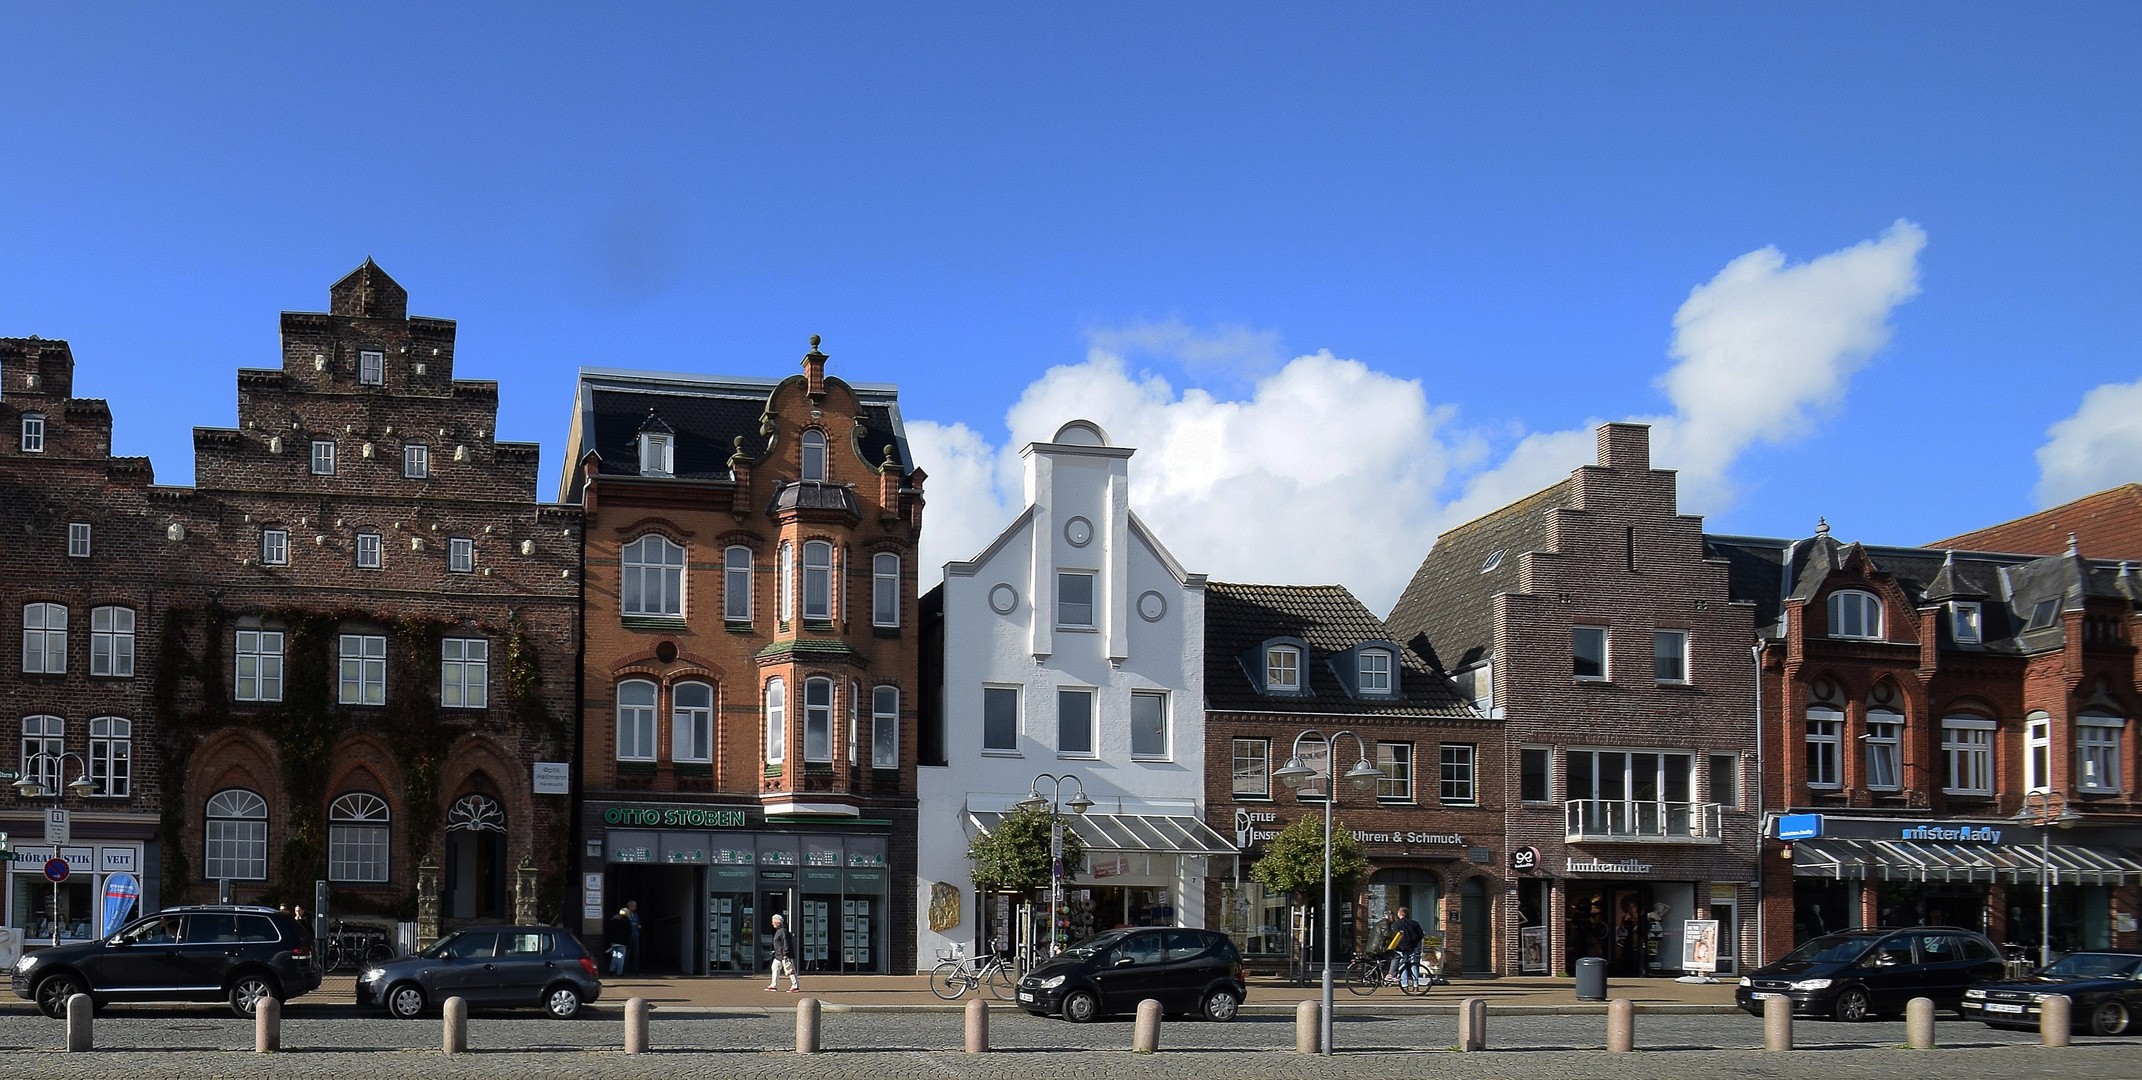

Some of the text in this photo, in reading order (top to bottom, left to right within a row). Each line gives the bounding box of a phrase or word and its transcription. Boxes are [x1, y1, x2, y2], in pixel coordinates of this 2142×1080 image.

[604, 807, 746, 827] OTTO STÖBEN
[1352, 830, 1462, 844] Uhren & Schmuck
[18, 852, 131, 864] HÖRASTIK VEIT
[1566, 857, 1653, 873] hunkemöller
